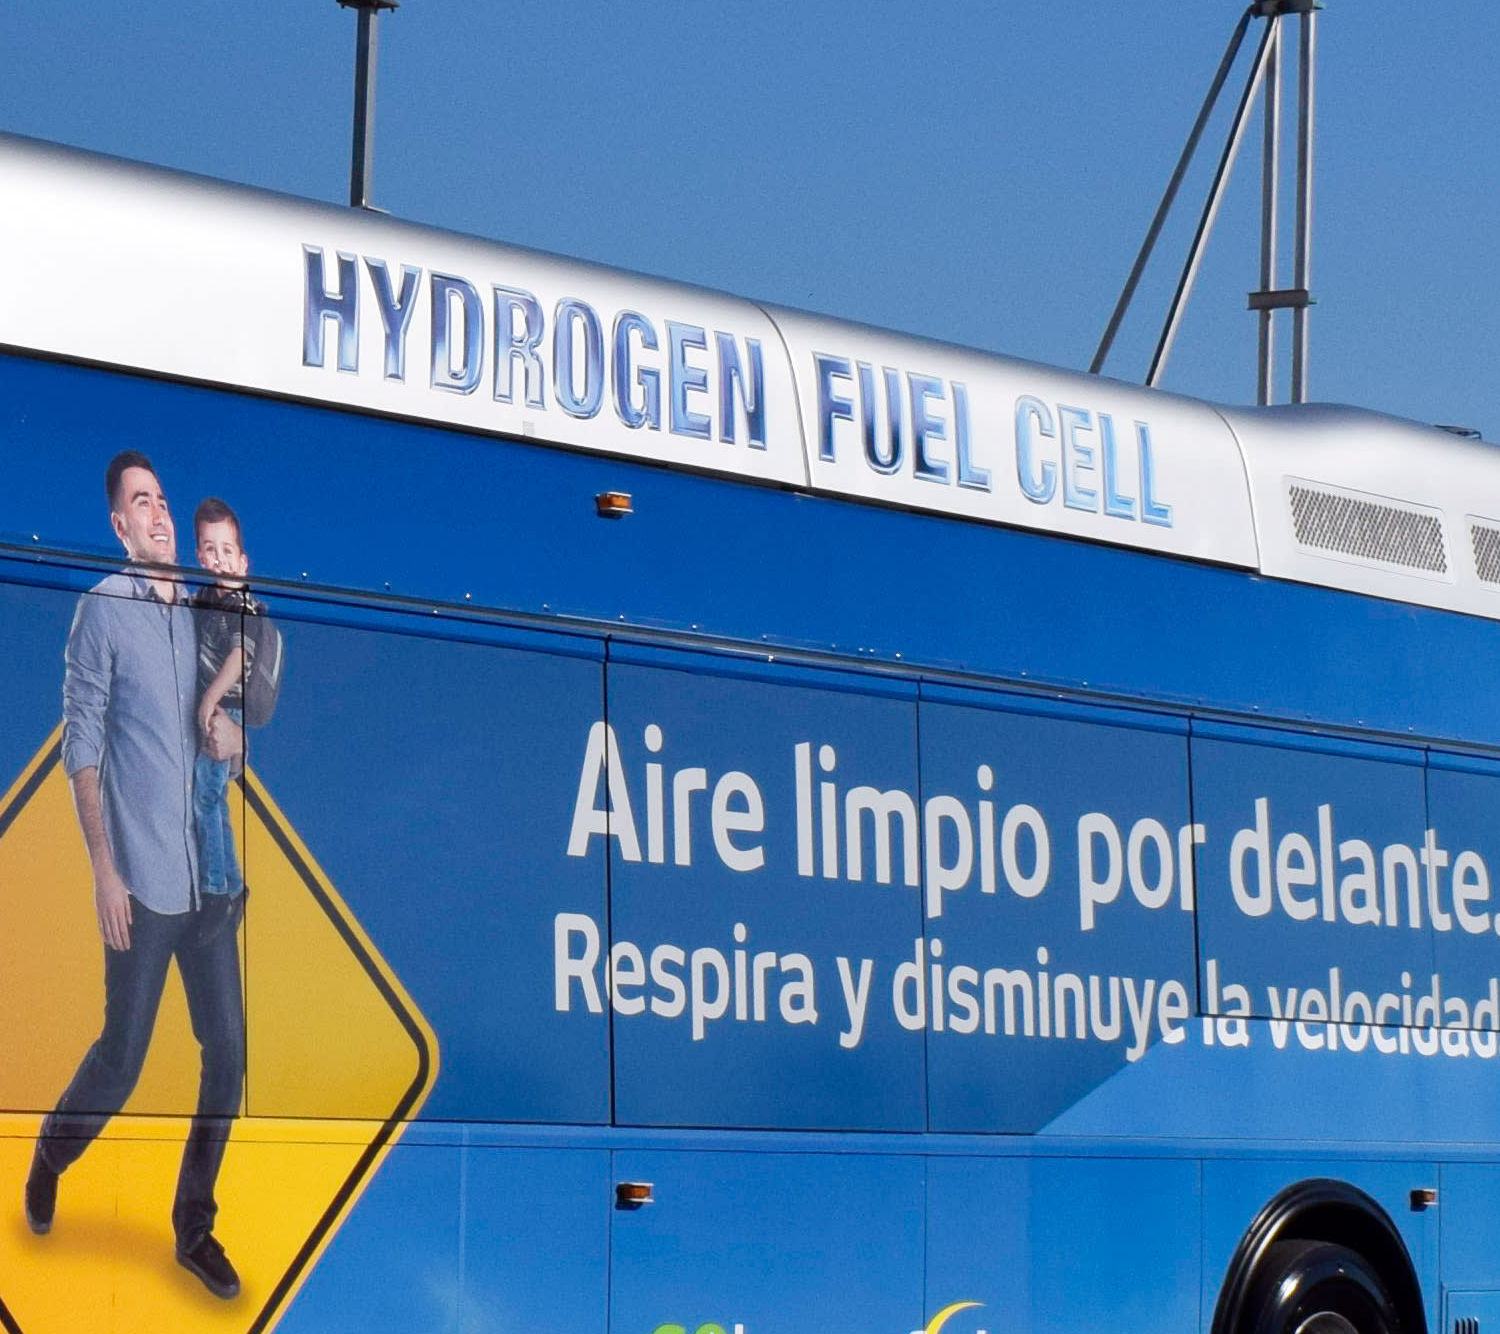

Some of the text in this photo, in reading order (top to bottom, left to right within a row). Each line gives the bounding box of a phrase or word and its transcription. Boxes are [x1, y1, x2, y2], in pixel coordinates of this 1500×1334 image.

[301, 243, 1174, 528] HYDROGEN FUEL CELL
[566, 720, 765, 872] Aire
[794, 741, 1051, 919] limpio
[1077, 812, 1207, 931] por
[554, 912, 819, 1041] Respira
[836, 956, 874, 1049] y
[893, 937, 1189, 1062] disminuye
[1202, 958, 1252, 1047] la
